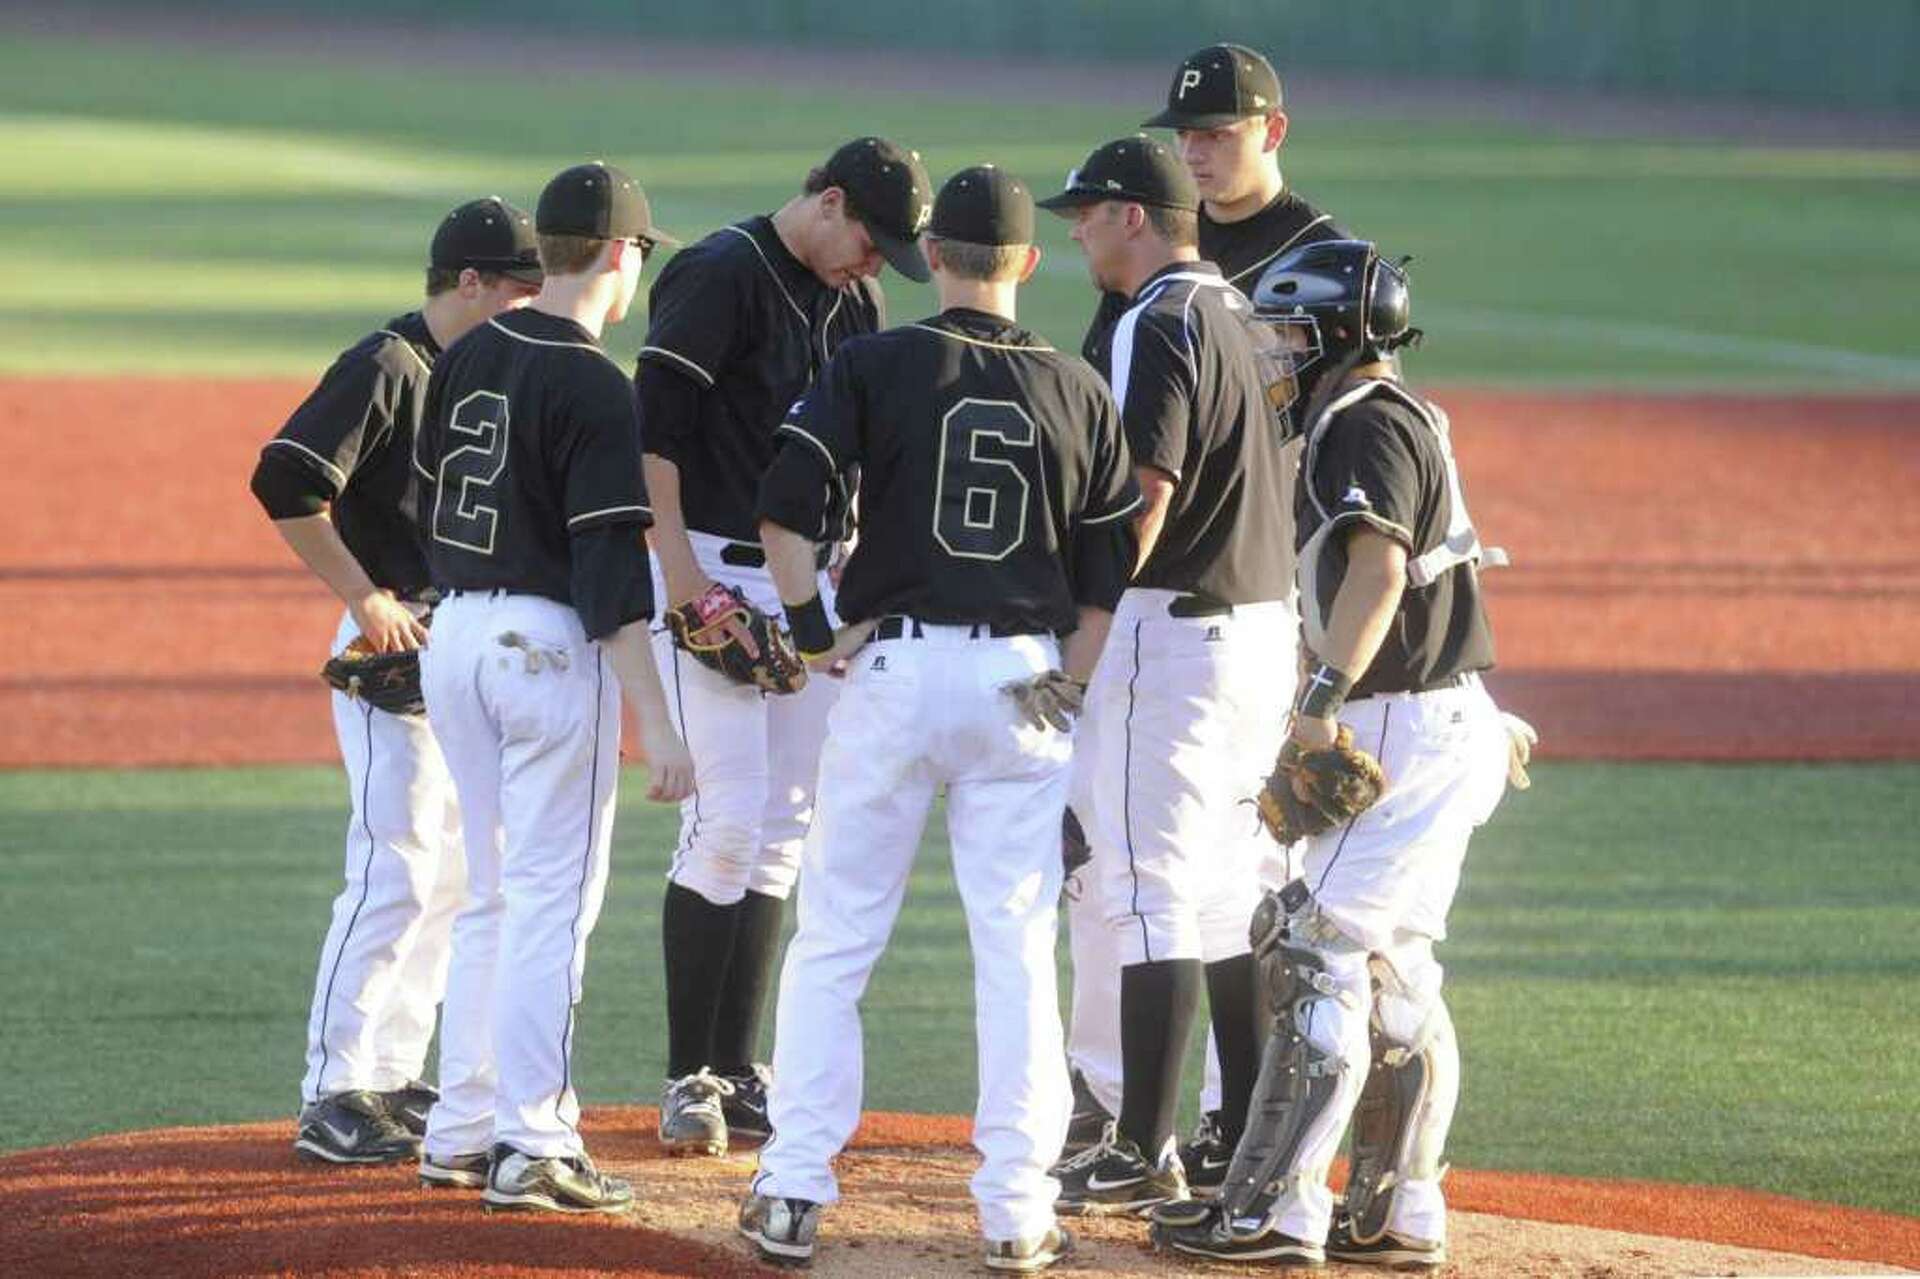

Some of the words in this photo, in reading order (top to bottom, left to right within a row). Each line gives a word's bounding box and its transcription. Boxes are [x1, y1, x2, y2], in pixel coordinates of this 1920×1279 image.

[1179, 70, 1201, 99] P
[433, 390, 509, 555] 2
[933, 397, 1035, 560] 6
